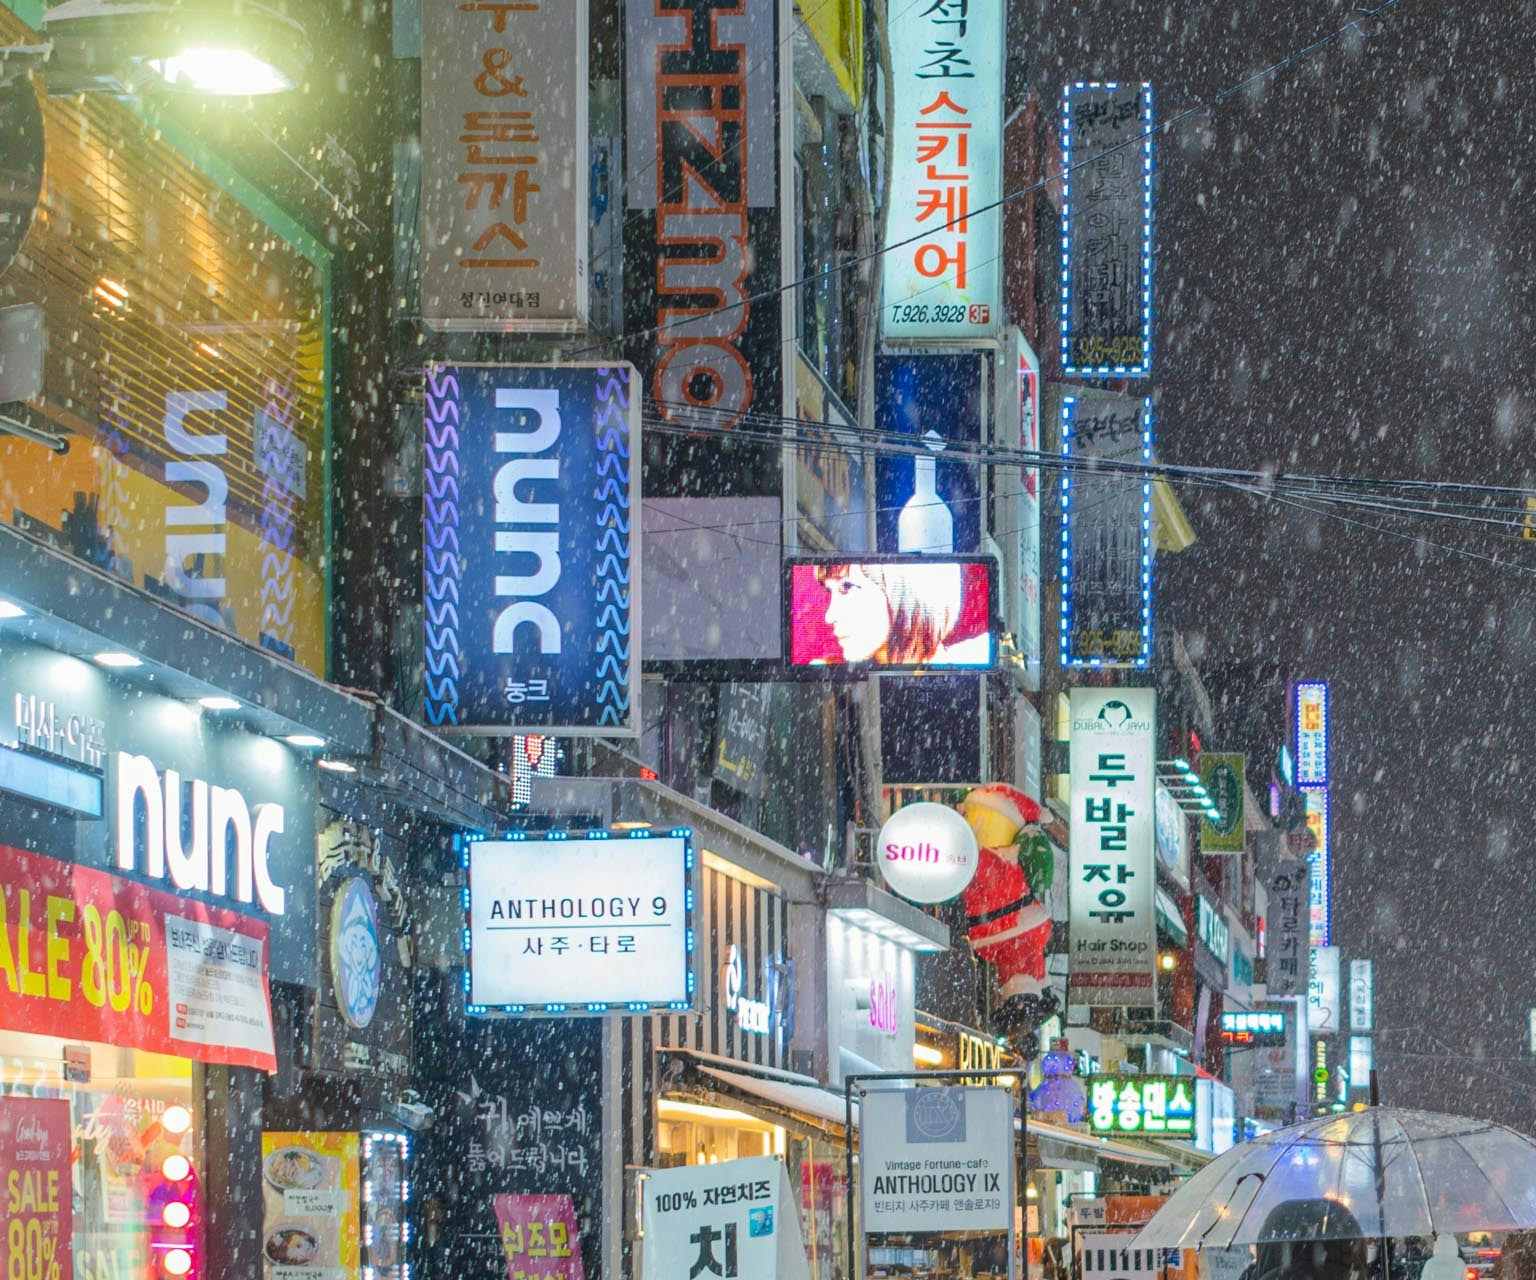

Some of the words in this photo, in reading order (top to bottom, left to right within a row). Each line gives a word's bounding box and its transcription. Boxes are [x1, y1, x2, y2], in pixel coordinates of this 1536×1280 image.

[914, 91, 972, 289] 스킨케어
[459, 291, 541, 308] 성신여대점
[971, 307, 989, 323] 3F
[493, 388, 562, 654] nunc
[505, 678, 549, 704] 눙크
[117, 751, 285, 915] nunc
[490, 896, 641, 920] ANTHOLOGY
[652, 896, 667, 916] 9
[140, 922, 152, 943] TO
[1077, 938, 1108, 952] Hair
[1109, 938, 1148, 956] Shop
[1091, 1079, 1194, 1131] 방송댄스
[885, 1160, 921, 1171] Vintage
[924, 1158, 988, 1170] Fortune-cafe
[8, 1169, 60, 1214] SALE
[873, 1173, 977, 1195] ANTHOLOGY
[984, 1172, 1000, 1192] IX
[655, 1193, 697, 1213] 100%
[703, 1180, 771, 1204] 자연치즈
[874, 1199, 906, 1214] 빈티지
[909, 1199, 950, 1213] 사주카페
[953, 1198, 1000, 1212] 앤솔로지9
